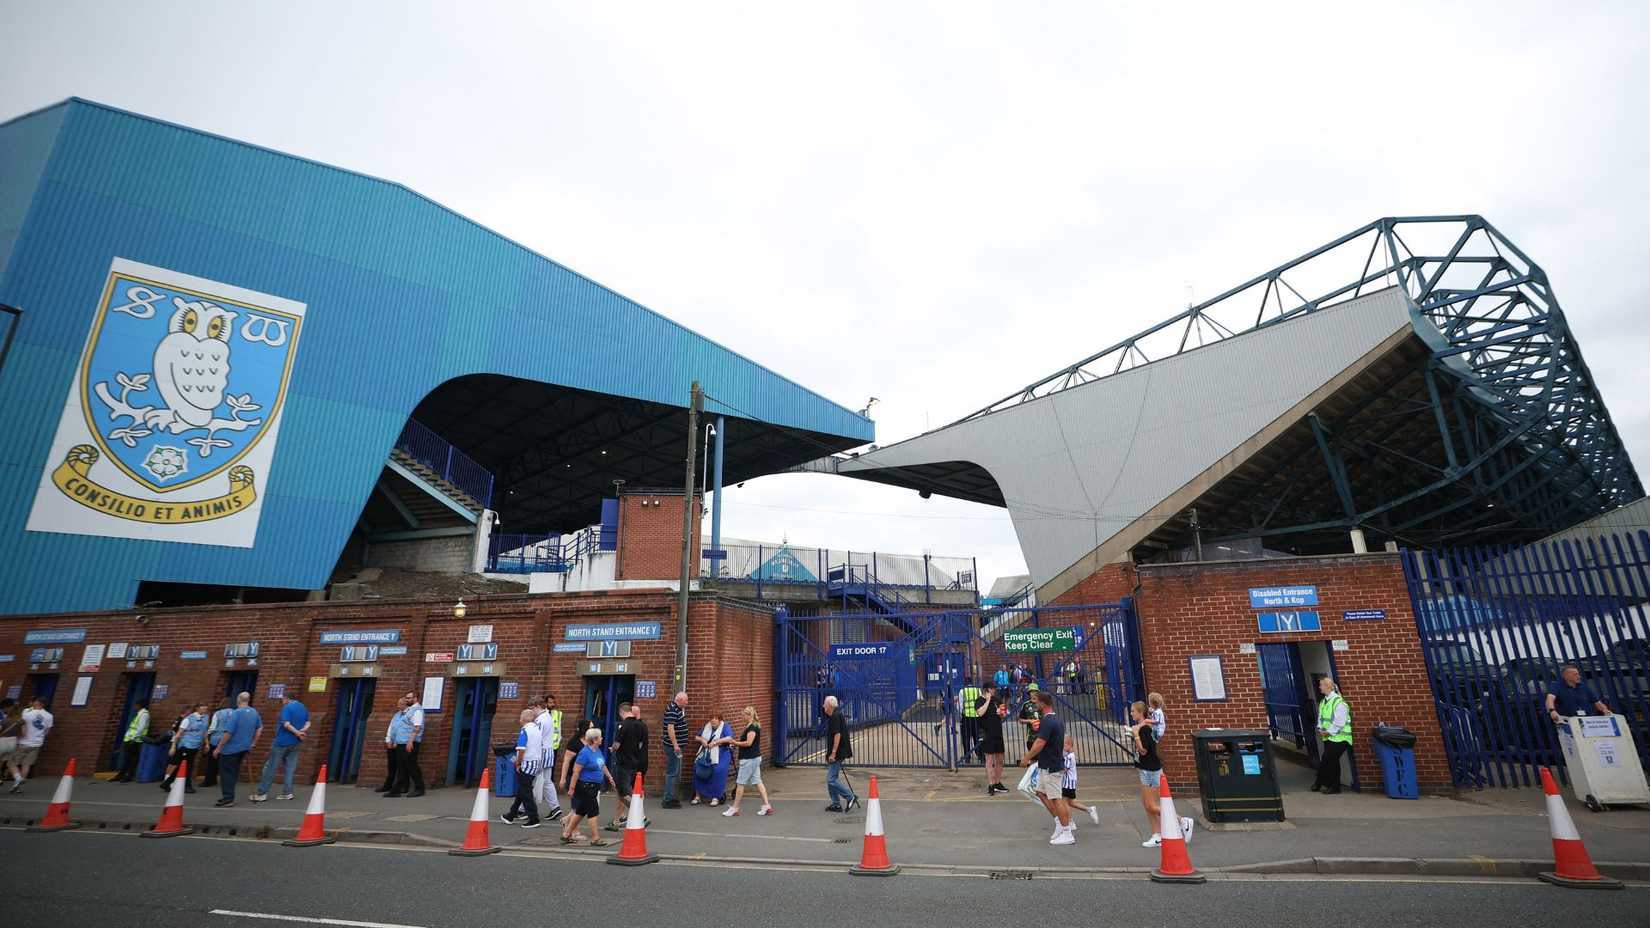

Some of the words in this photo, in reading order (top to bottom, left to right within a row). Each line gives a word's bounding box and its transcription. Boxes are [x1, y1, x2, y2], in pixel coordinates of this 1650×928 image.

[64, 477, 146, 518] CONSILIO
[154, 507, 174, 520] ET
[181, 495, 243, 520] ANIMIS
[1280, 614, 1295, 630] Y
[568, 627, 591, 637] NORTH
[592, 627, 615, 636] STAND
[615, 625, 650, 635] ENTRANCE
[651, 625, 657, 635] Y
[1003, 631, 1054, 642] Emergency
[1055, 630, 1073, 639] Exit
[462, 644, 470, 657] Y
[487, 644, 495, 657] Y
[605, 641, 614, 654] Y
[836, 647, 853, 656] EXIT
[855, 647, 877, 656] DOOR
[879, 646, 888, 654] 17
[1004, 640, 1028, 651] Keep
[1029, 640, 1054, 650] Clear
[345, 646, 353, 659] Y
[368, 646, 376, 659] Y
